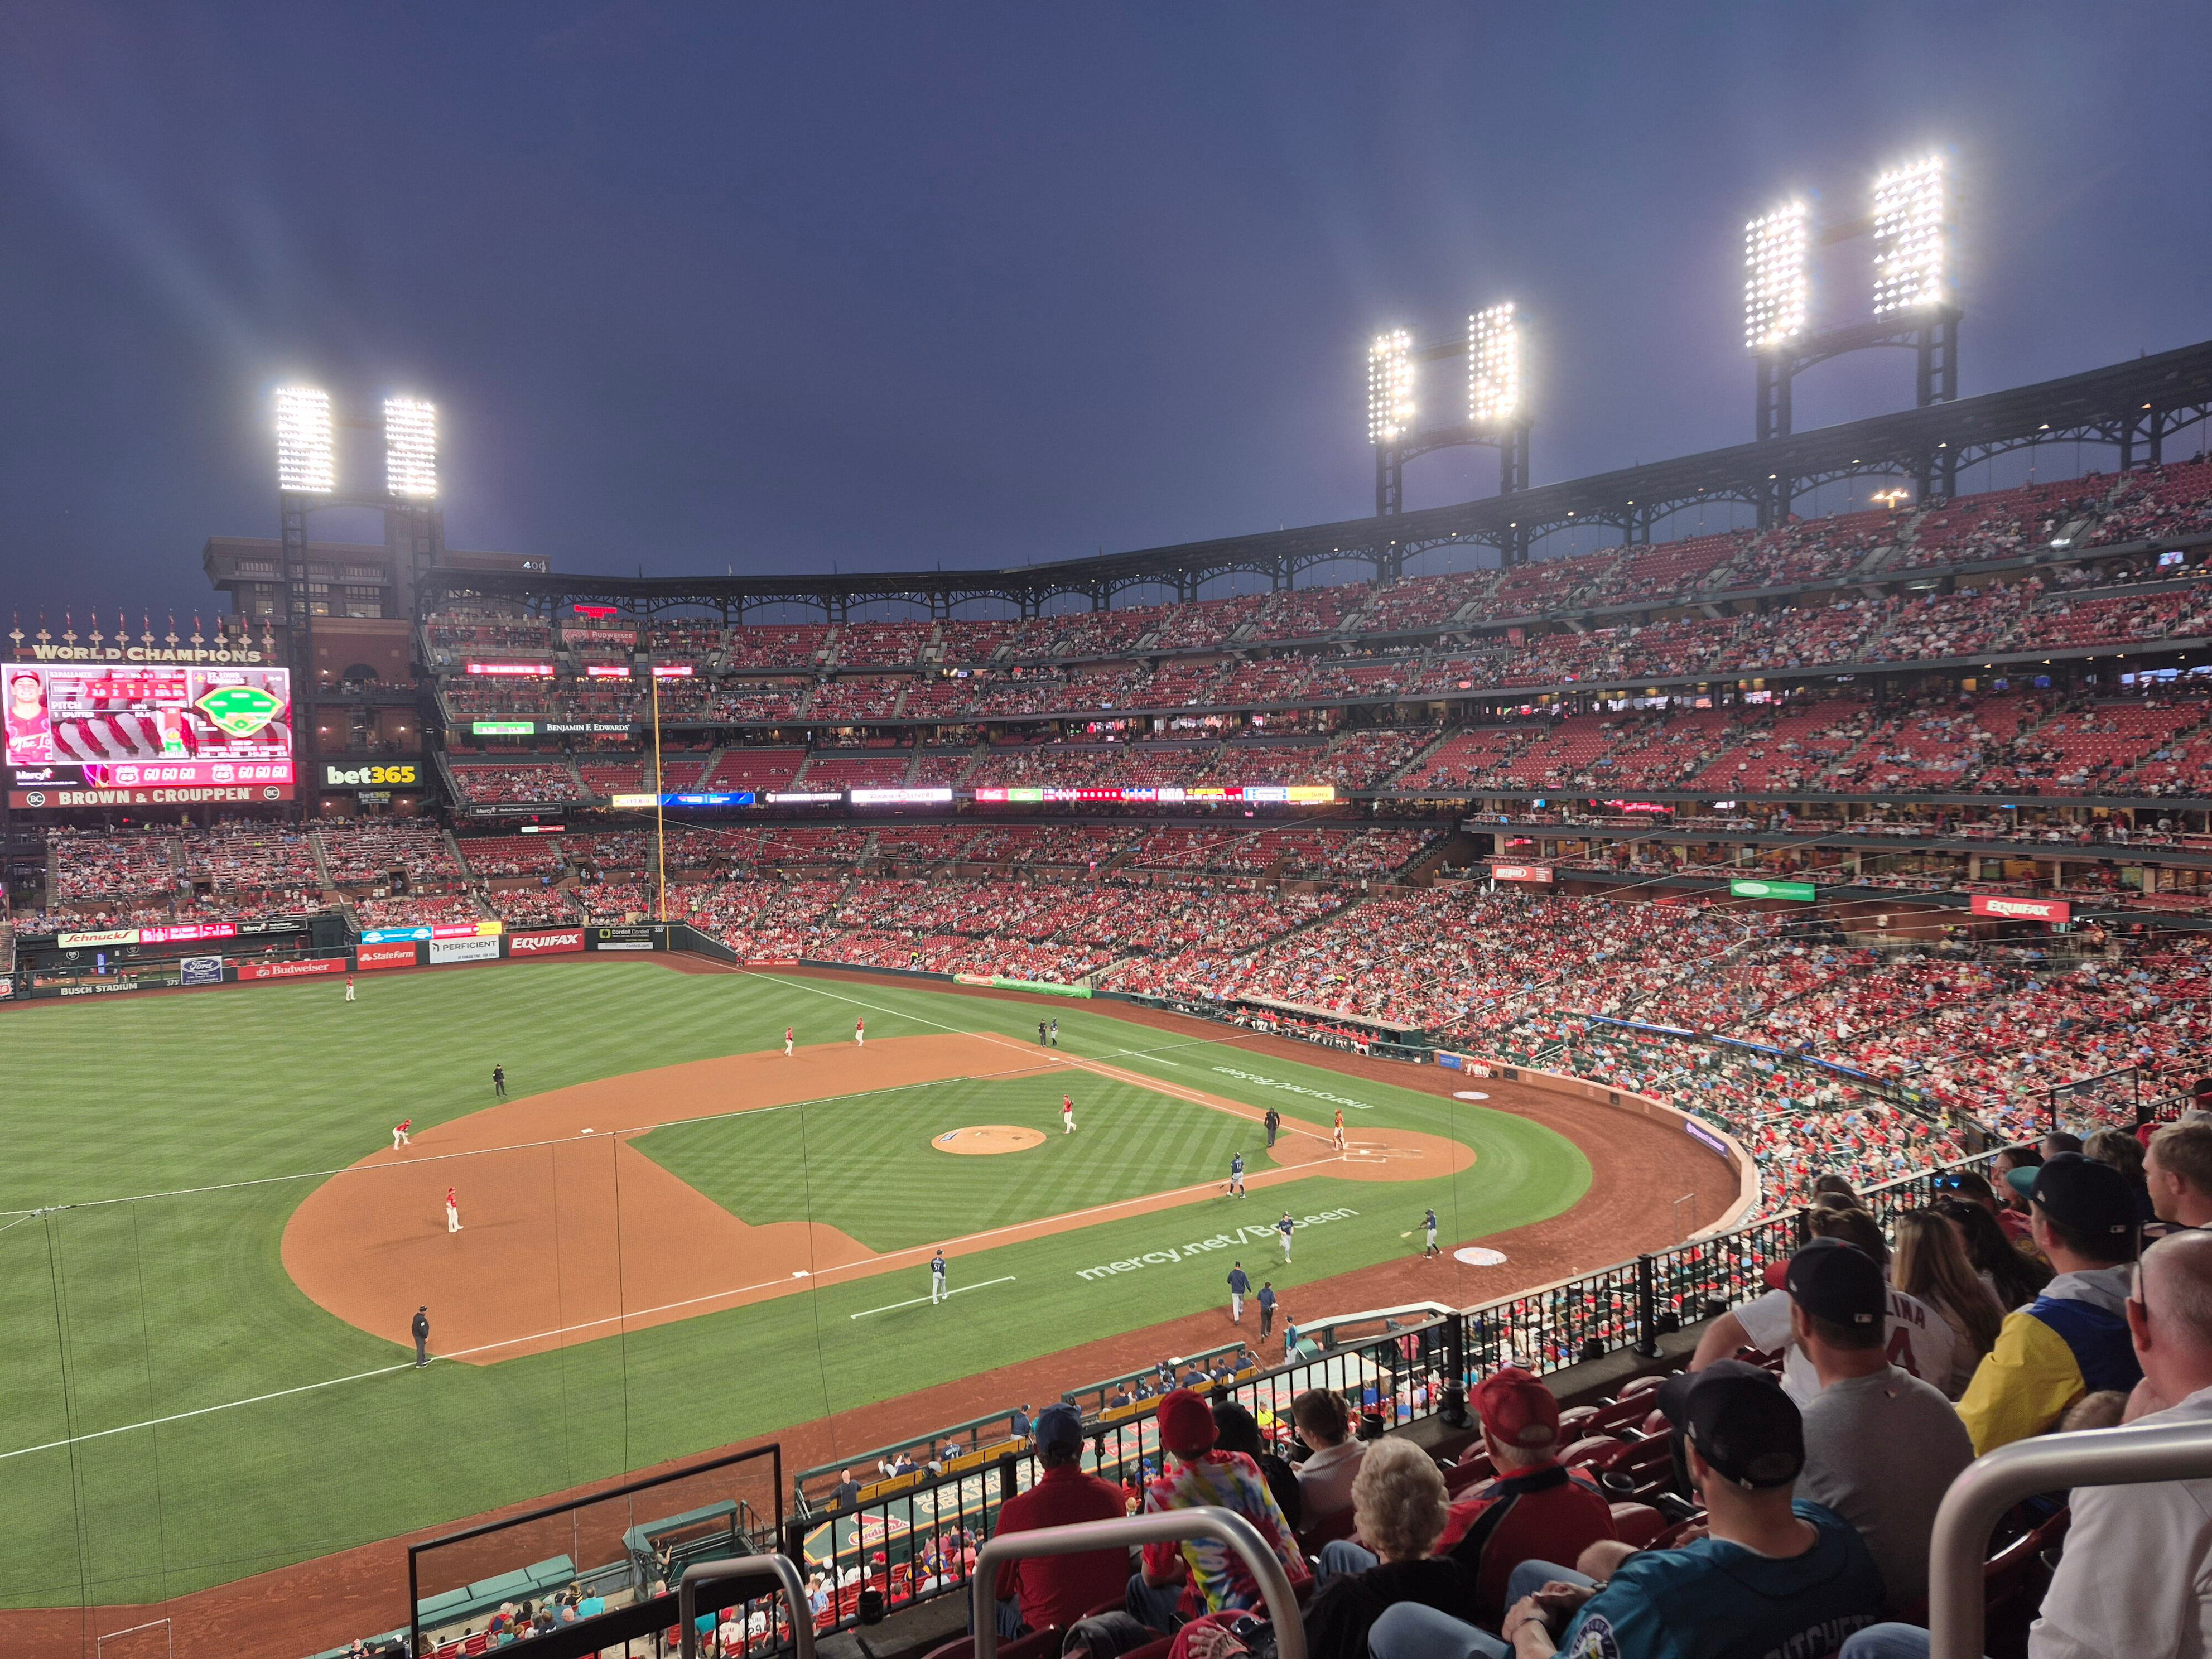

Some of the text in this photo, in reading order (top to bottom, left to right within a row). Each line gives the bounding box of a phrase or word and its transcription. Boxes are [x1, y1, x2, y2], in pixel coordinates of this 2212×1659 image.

[32, 645, 262, 663] WORLD CHAMPIONS
[51, 701, 82, 710] PITCH
[547, 724, 584, 732] BENJAMIN
[16, 770, 45, 781] Mercy
[327, 766, 416, 784] bet365
[59, 788, 250, 805] BROWN & CROUPPEN
[1986, 900, 2050, 916] EQUIFAX
[442, 941, 497, 951] PERFICIENT
[511, 934, 579, 951] EQUIFAX
[190, 960, 214, 970] Ford
[272, 963, 329, 975] Budweiser
[61, 983, 138, 995] BUSCH STADIUM
[1886, 1294, 1925, 1329] INA
